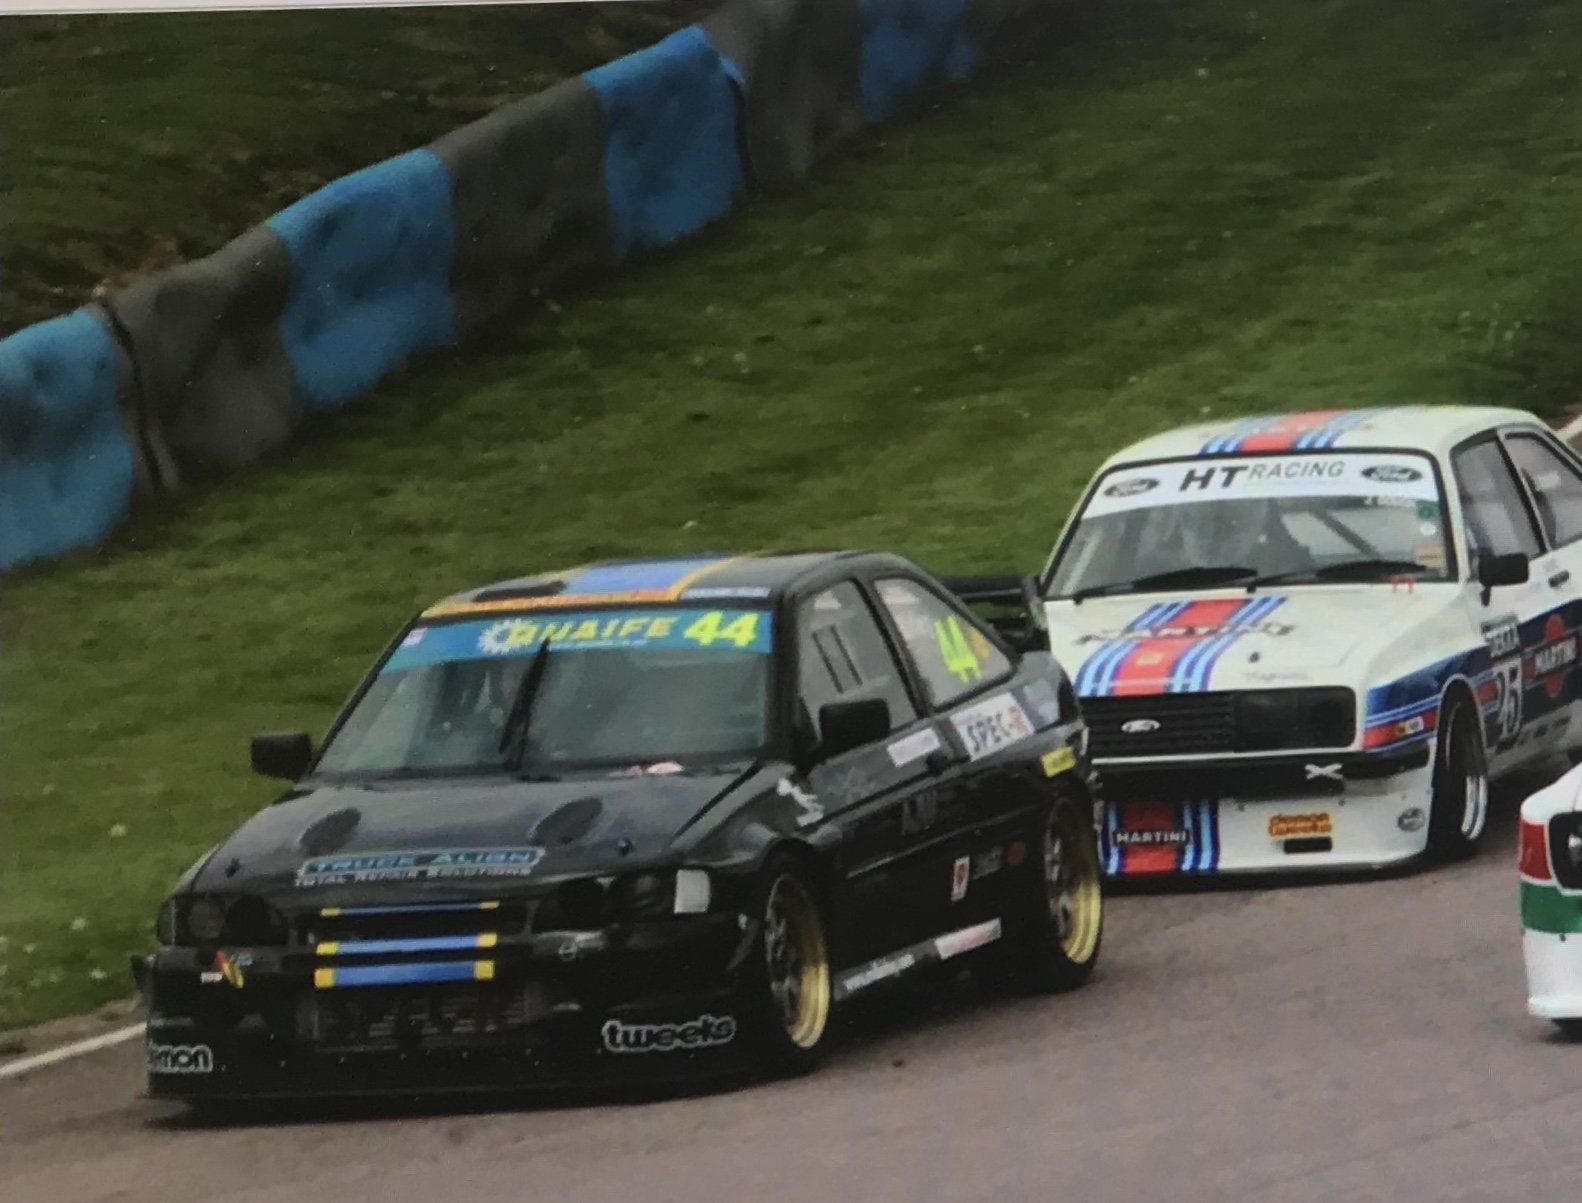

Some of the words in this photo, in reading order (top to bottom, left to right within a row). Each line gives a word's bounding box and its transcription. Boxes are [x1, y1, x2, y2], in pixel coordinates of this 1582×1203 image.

[1180, 465, 1250, 492] HT
[1249, 460, 1346, 480] RACING
[683, 609, 759, 648] 44
[934, 614, 984, 685] 44
[1115, 830, 1188, 845] MARTINI
[601, 1013, 737, 1053] tweeks
